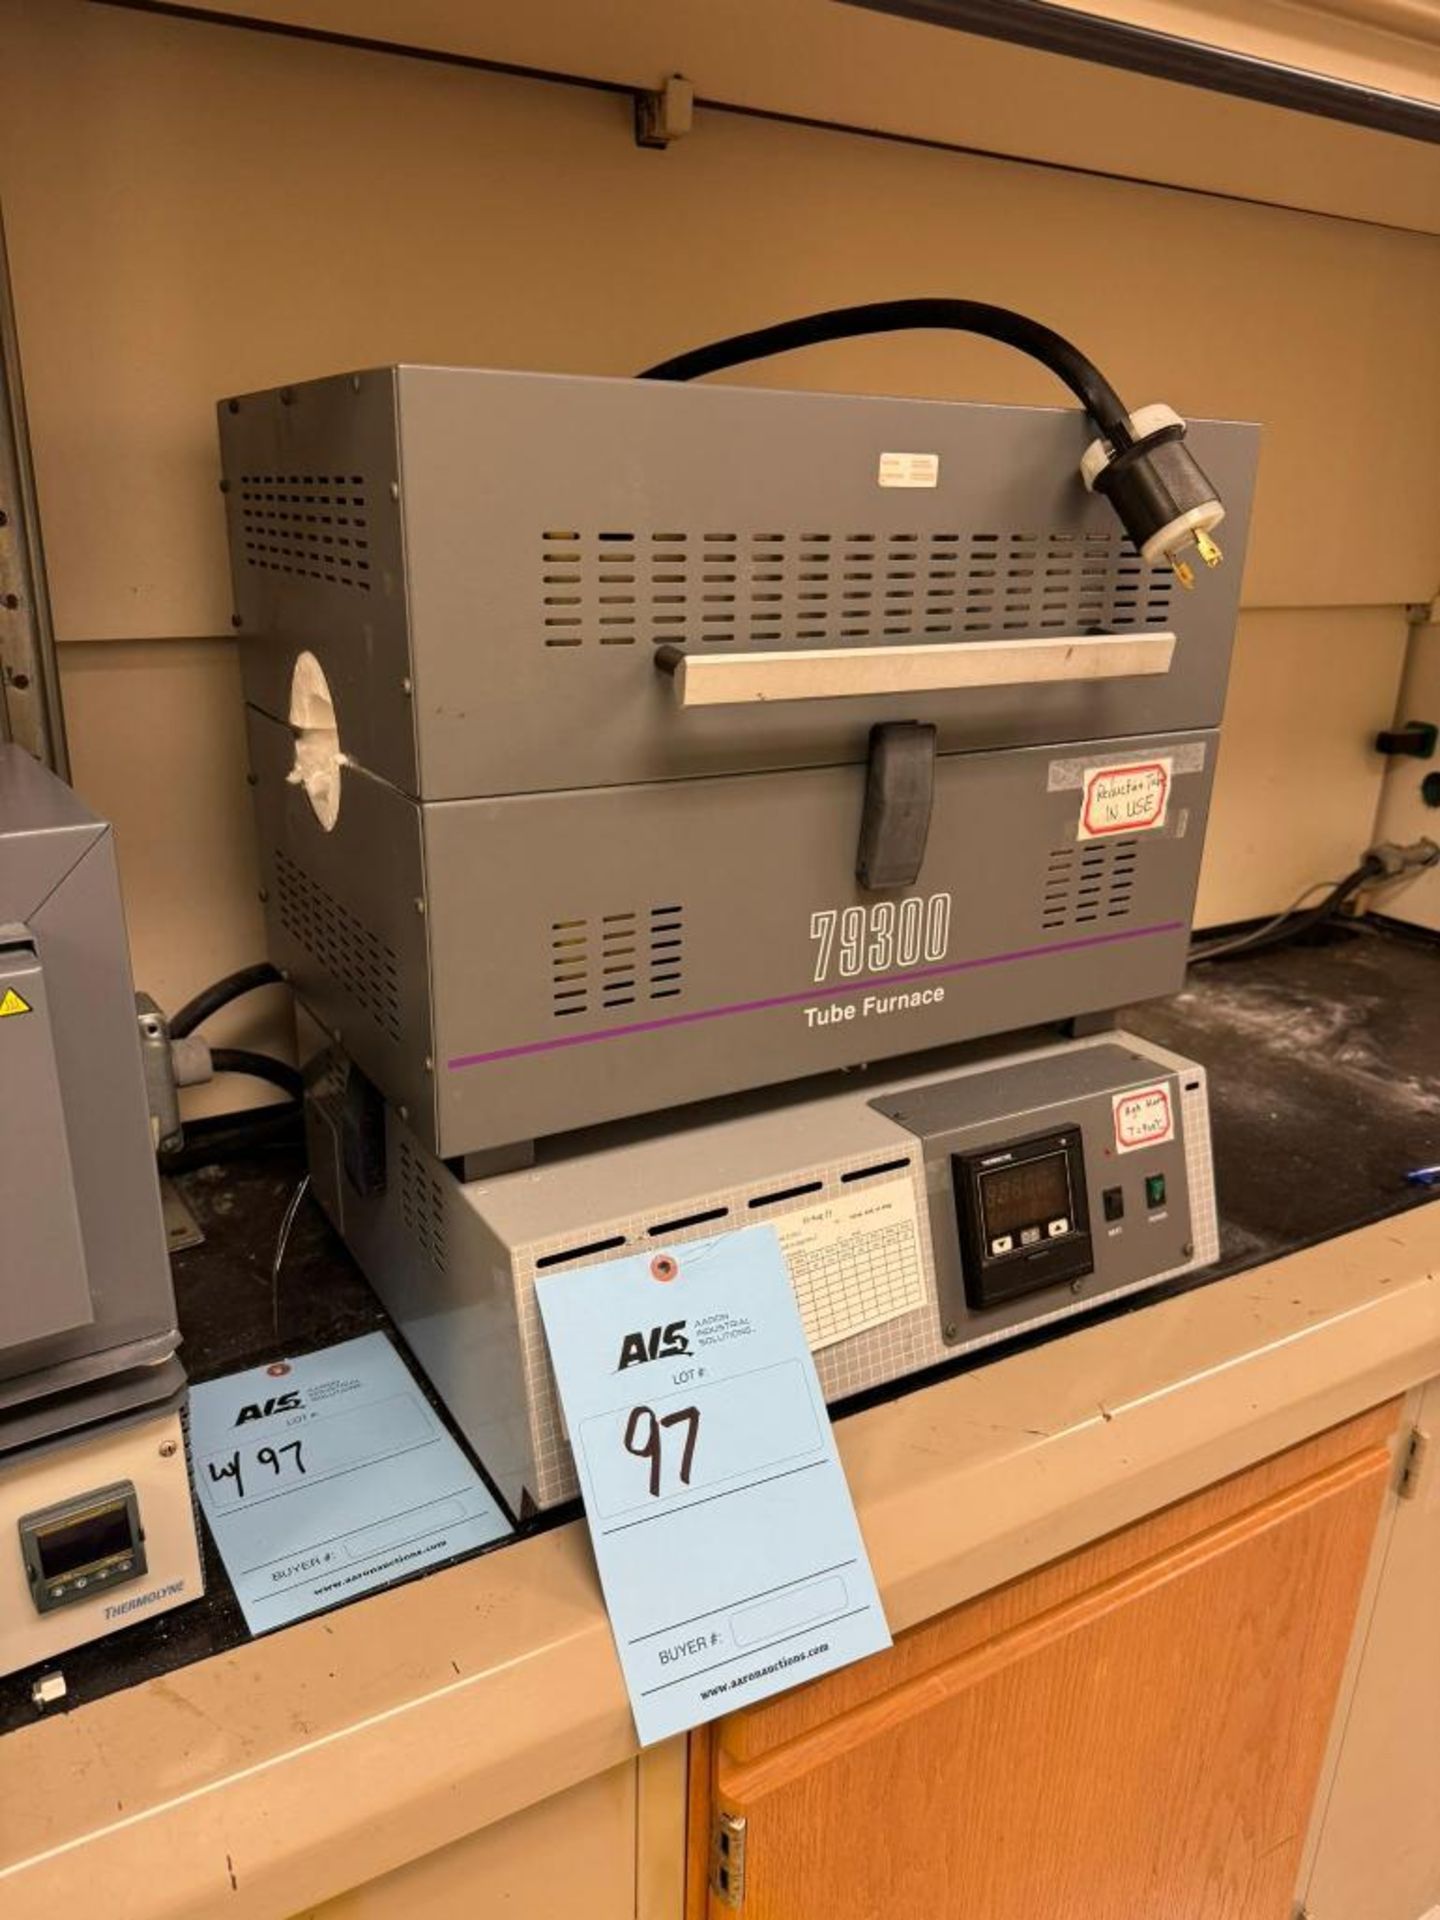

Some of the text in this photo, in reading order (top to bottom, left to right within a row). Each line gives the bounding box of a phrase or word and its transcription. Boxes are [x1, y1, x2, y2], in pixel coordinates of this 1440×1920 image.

[1126, 794, 1154, 817] USE
[809, 892, 951, 982] 79300
[803, 987, 945, 1027] Tube Furnace
[617, 1320, 693, 1372] AIS
[672, 1368, 696, 1385] LOT
[234, 1390, 303, 1426] AIS
[257, 1440, 306, 1475] 97
[624, 1405, 700, 1497] 97
[272, 1557, 321, 1582] BUYER
[103, 1581, 184, 1620] THERMOLYNE
[658, 1635, 709, 1665] BUYER
[700, 1642, 829, 1701] www.aaronauctions.com
